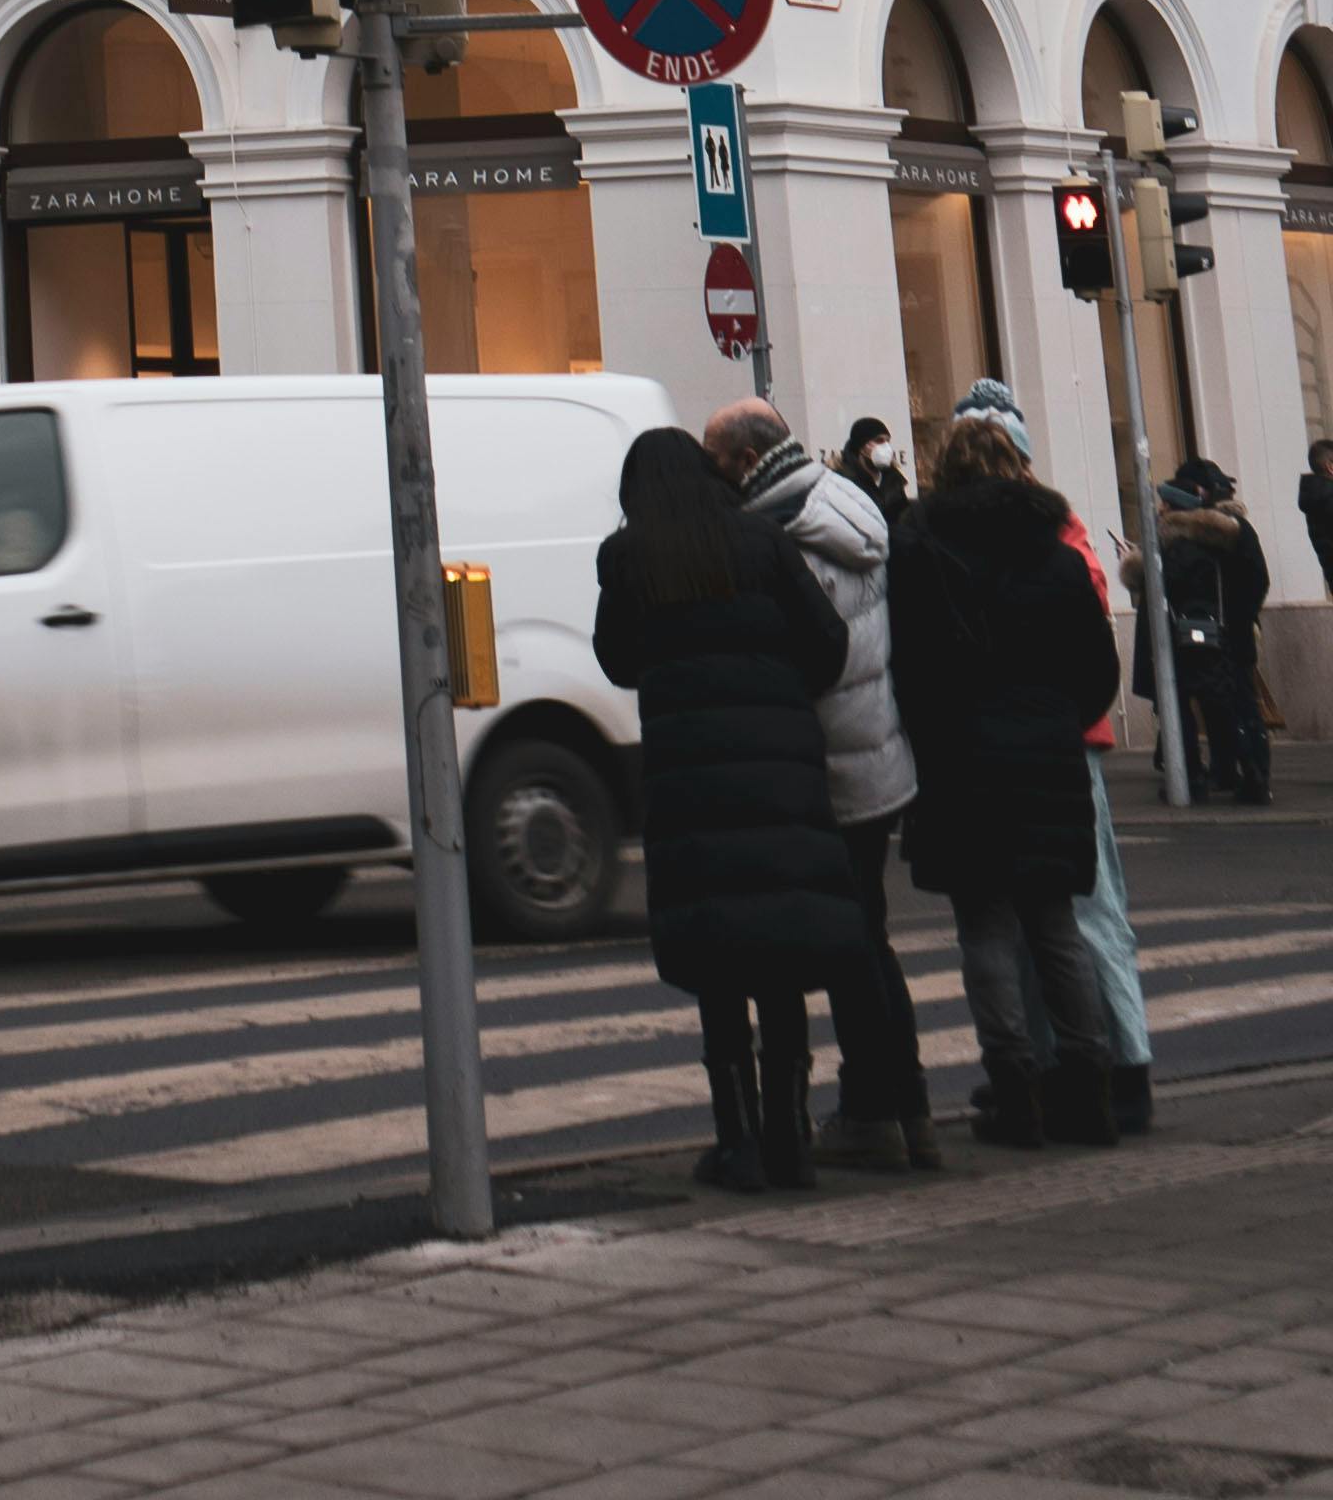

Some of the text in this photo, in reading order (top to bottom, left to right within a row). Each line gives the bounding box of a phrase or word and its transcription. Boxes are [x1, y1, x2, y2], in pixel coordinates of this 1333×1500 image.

[646, 51, 720, 83] ENDE
[473, 166, 553, 184] HOME
[936, 168, 980, 187] HOME
[31, 187, 182, 210] ZARA HOME
